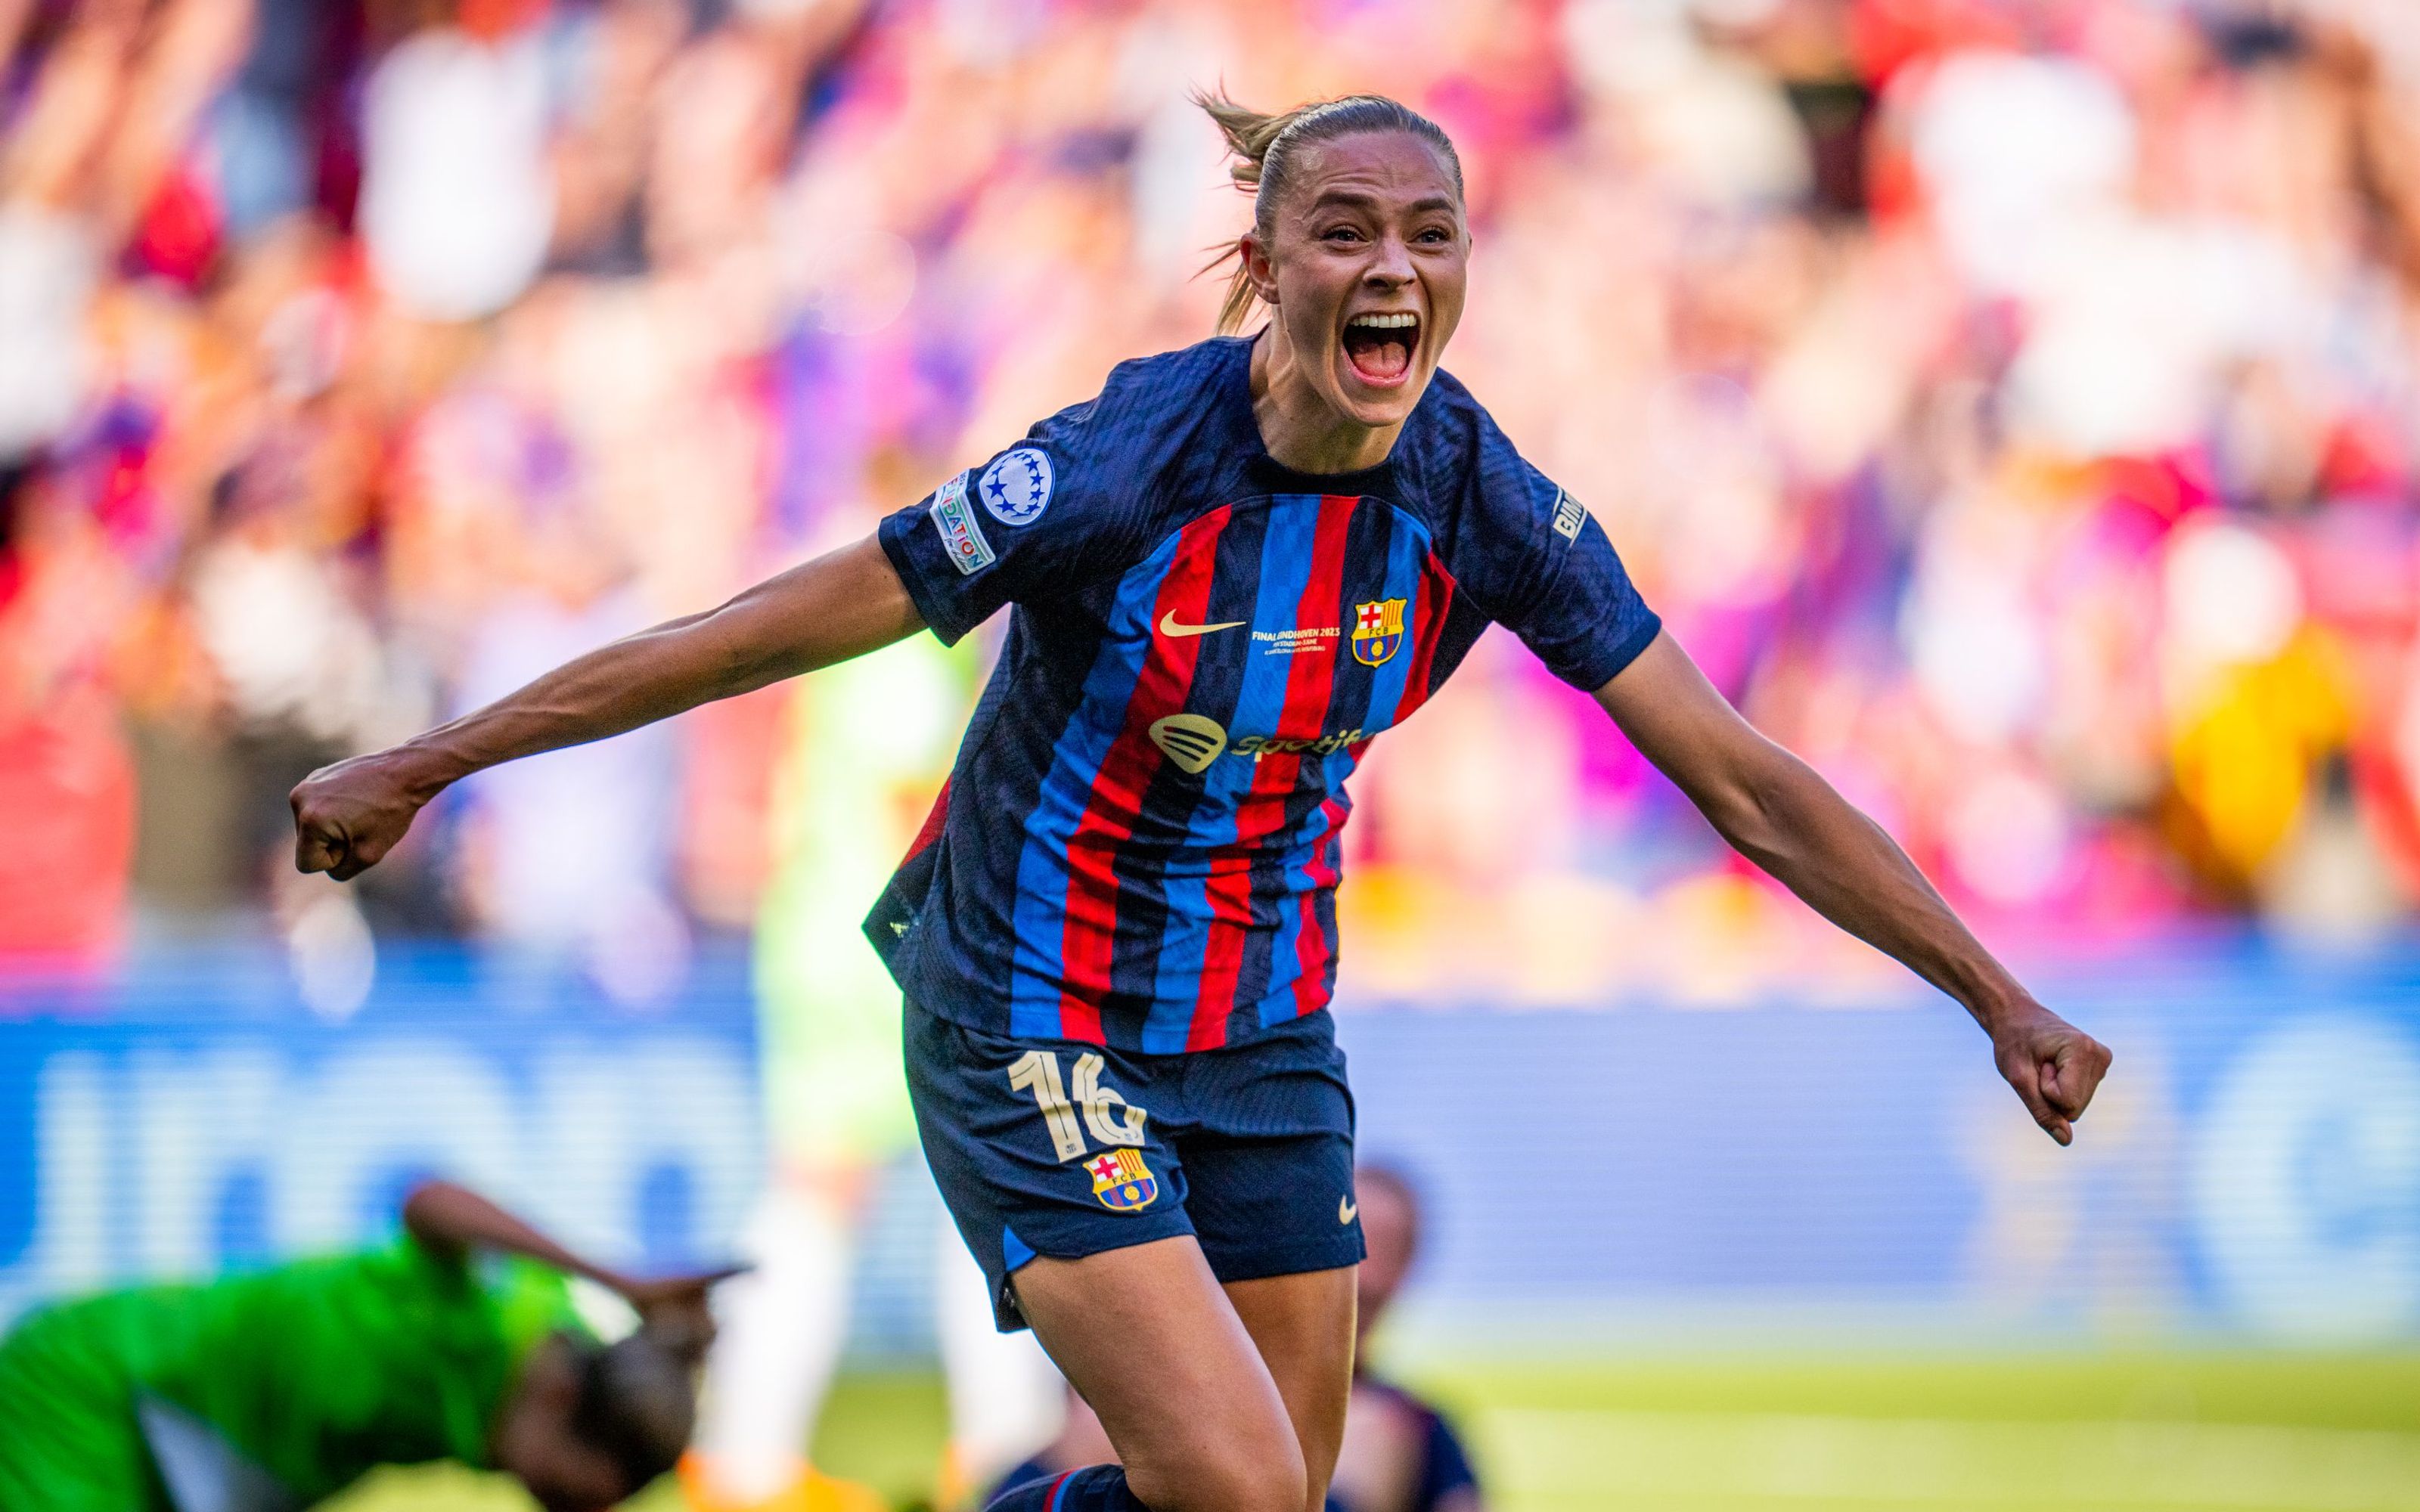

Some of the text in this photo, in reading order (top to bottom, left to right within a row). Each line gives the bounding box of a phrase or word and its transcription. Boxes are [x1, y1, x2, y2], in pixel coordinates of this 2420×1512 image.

[1252, 631, 1277, 641] FINAL
[1320, 627, 1341, 637] 2023
[1368, 628, 1389, 637] FCB
[1230, 729, 1376, 762] Spotif
[1007, 1050, 1147, 1163] 16
[1112, 1172, 1137, 1186] FCB
